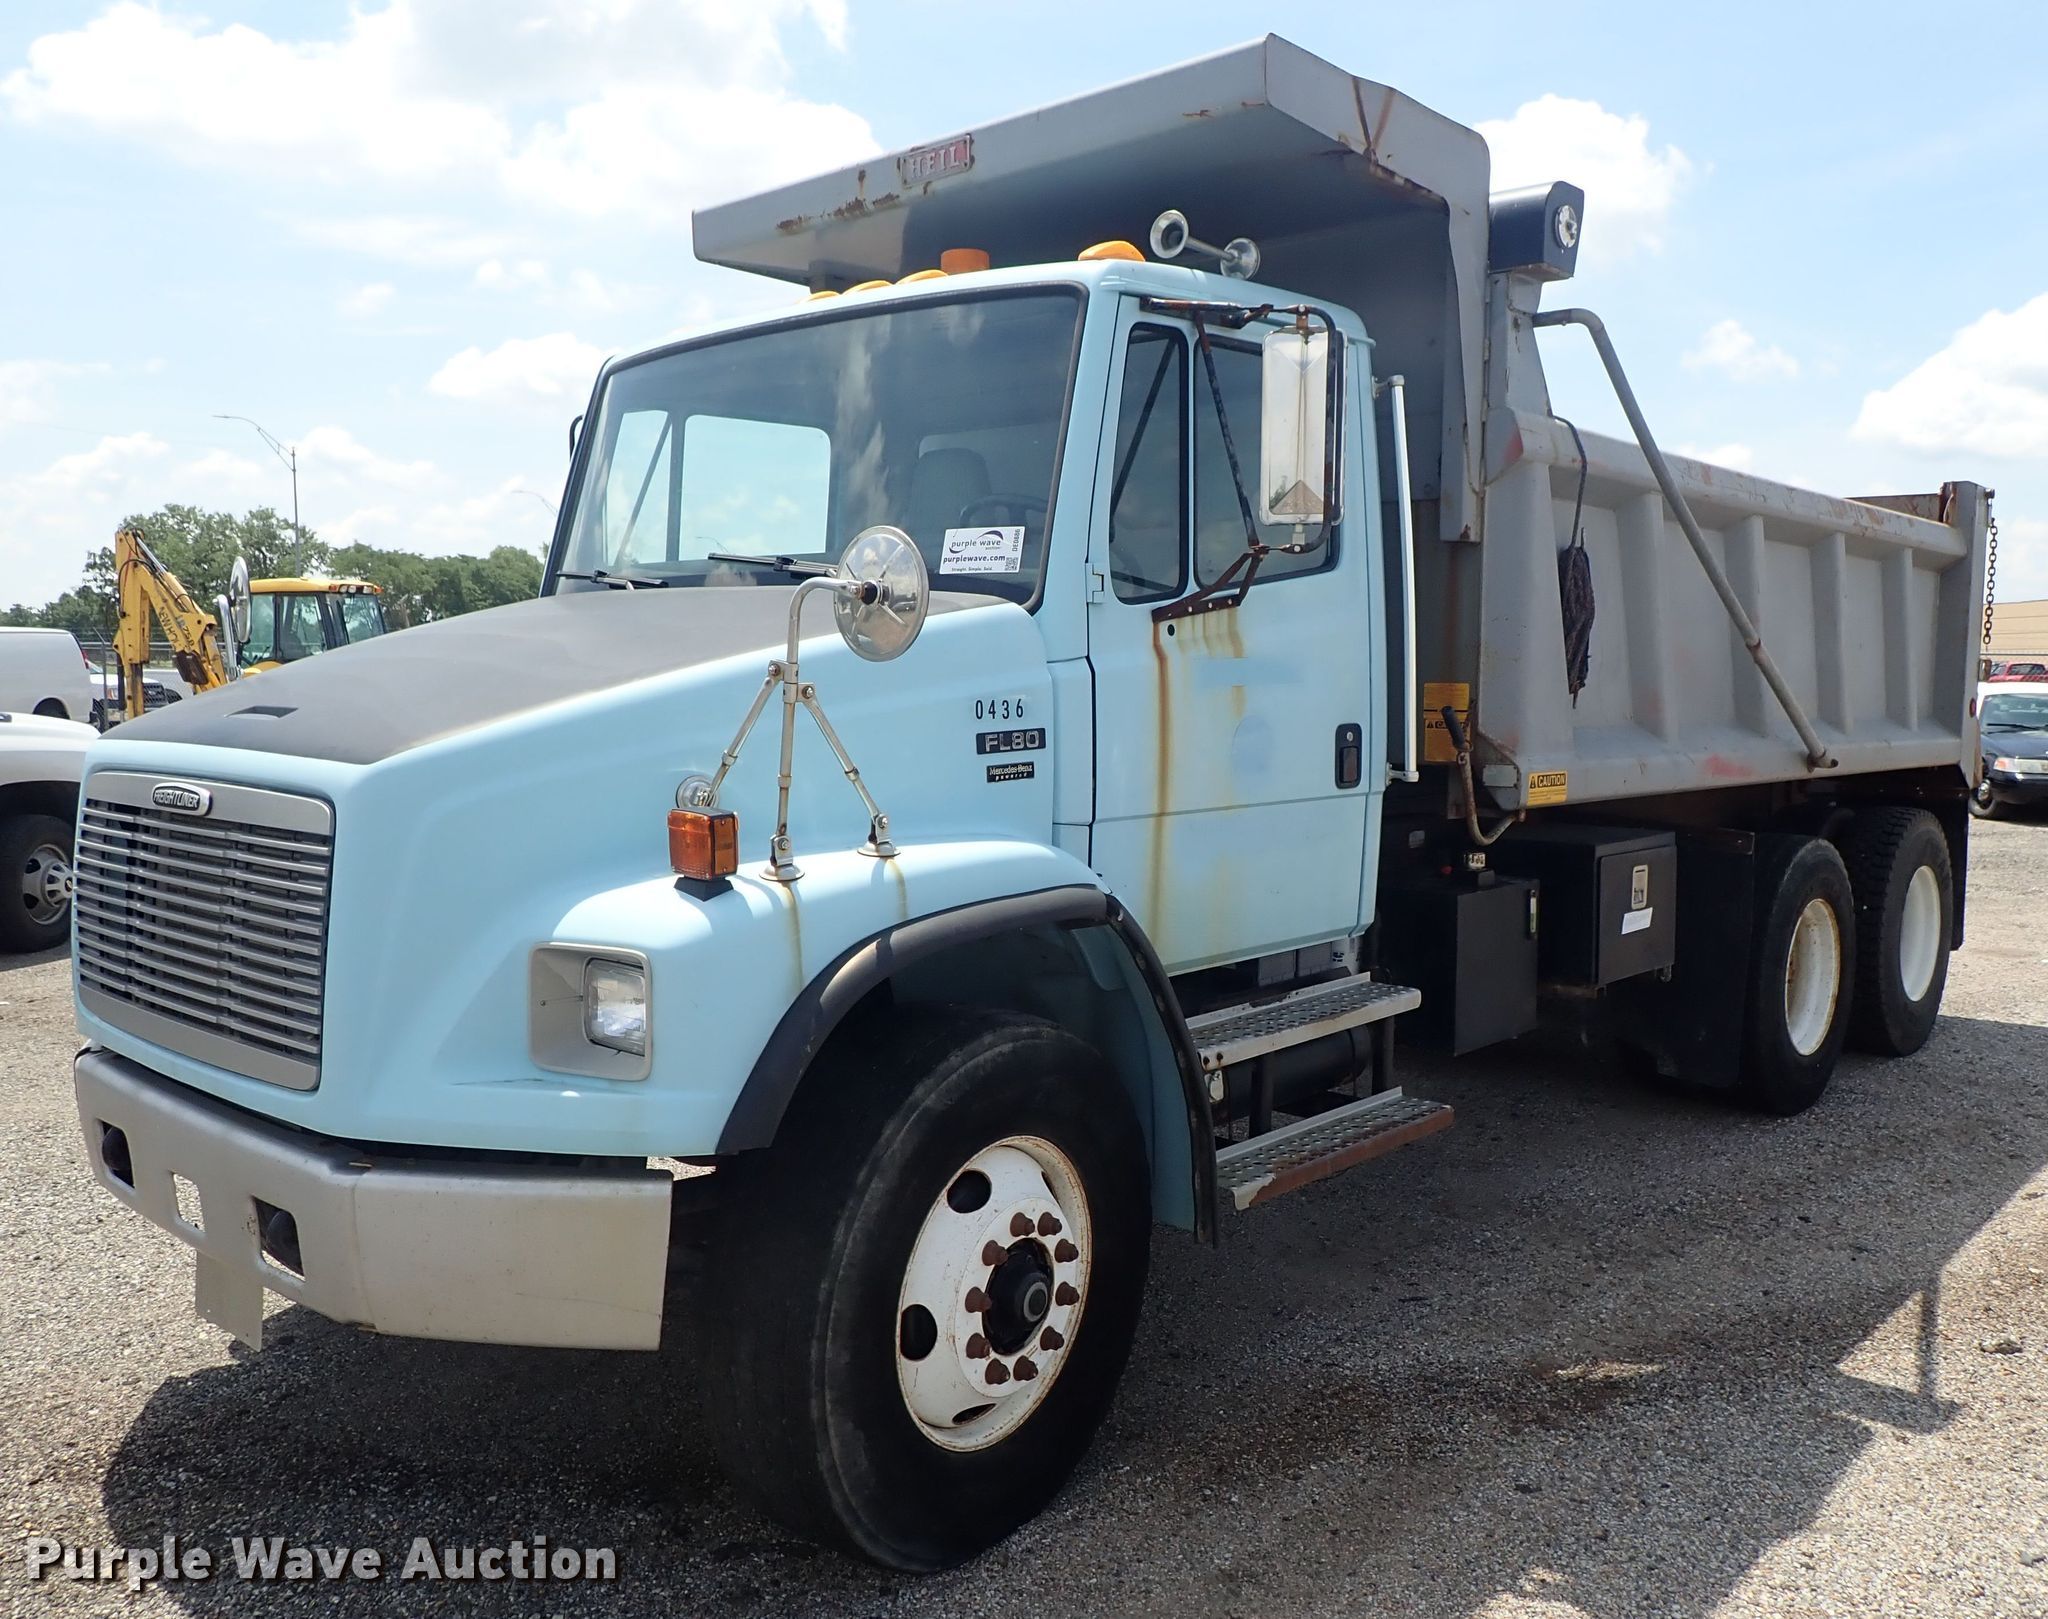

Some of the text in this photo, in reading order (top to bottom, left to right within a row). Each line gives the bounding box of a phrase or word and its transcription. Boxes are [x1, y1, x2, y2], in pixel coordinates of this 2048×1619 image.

[910, 146, 961, 179] HEIL
[951, 539, 977, 548] purple
[943, 554, 1006, 564] purplewave.com
[975, 698, 1024, 720] 0436
[985, 731, 1039, 752] FL80
[1538, 774, 1565, 787] CAUTION
[154, 789, 200, 808] FREIGHTLINER
